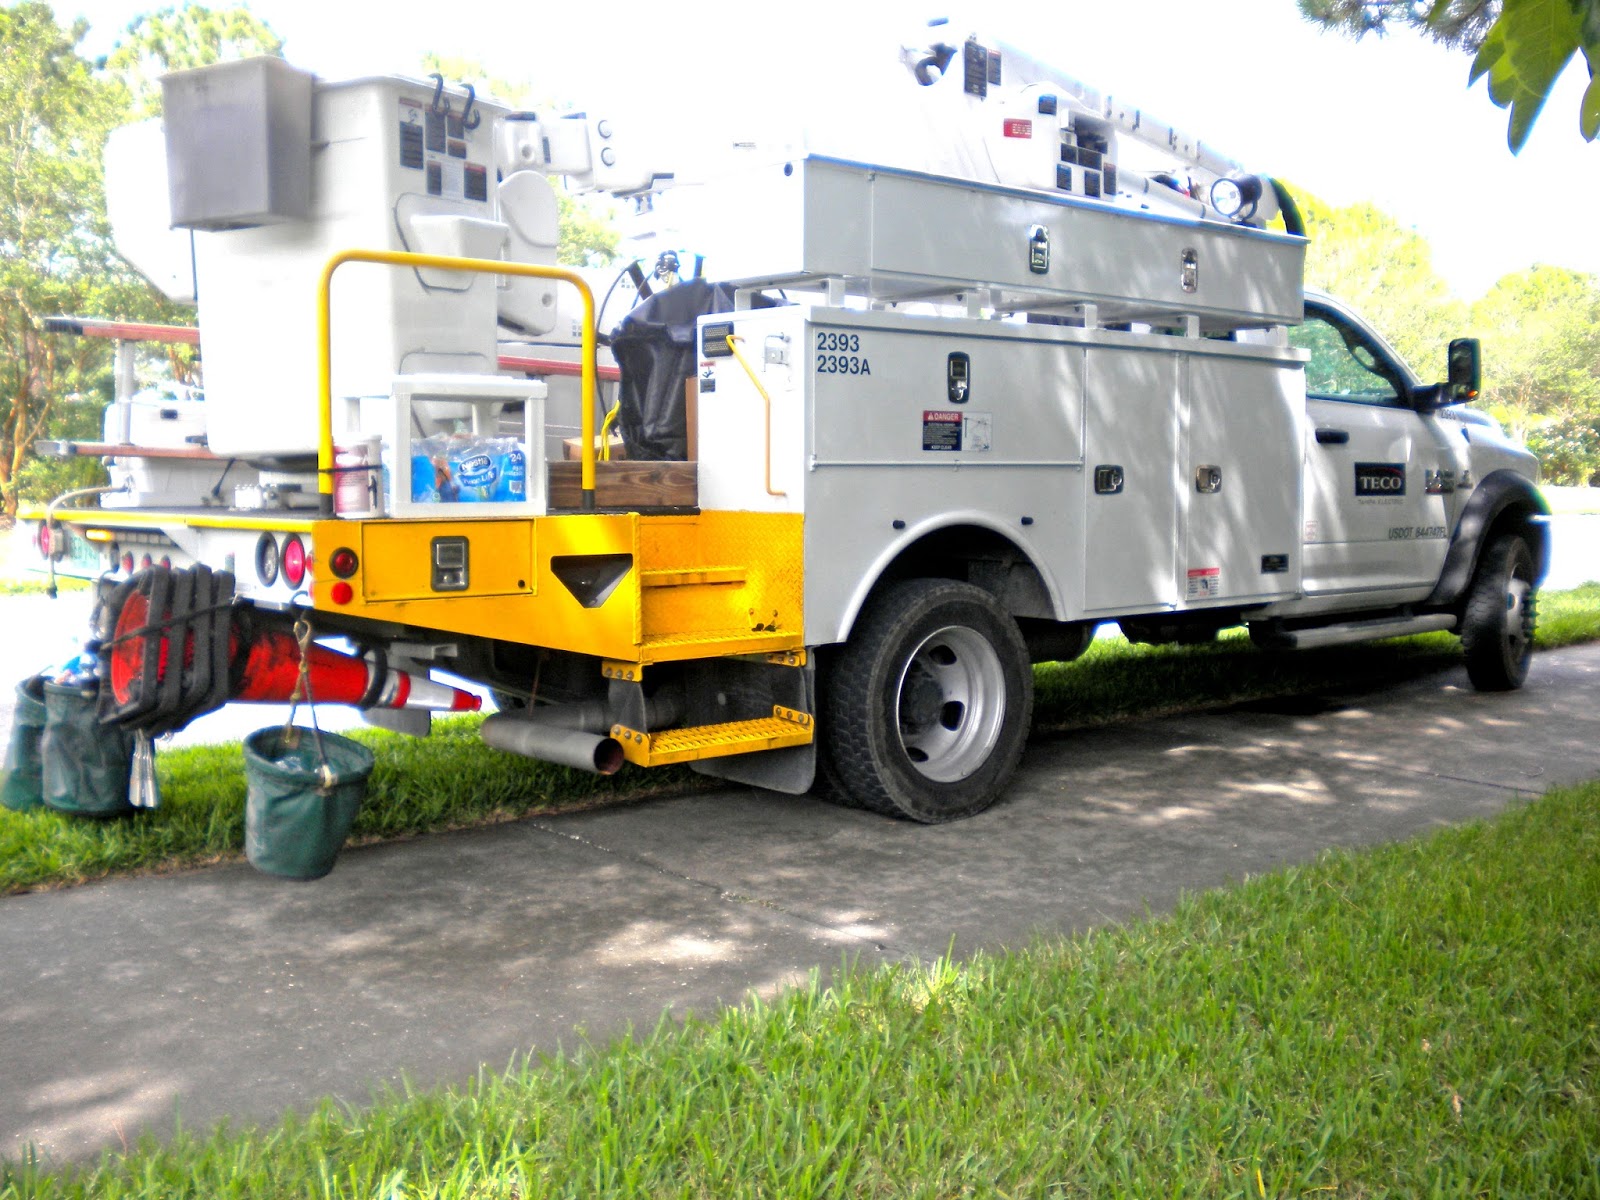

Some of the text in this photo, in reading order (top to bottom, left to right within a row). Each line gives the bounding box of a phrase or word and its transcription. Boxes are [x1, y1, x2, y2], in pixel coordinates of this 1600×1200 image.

[817, 332, 860, 352] 2393
[817, 354, 871, 375] 2393A
[934, 412, 959, 421] DANGER
[509, 453, 522, 463] 24
[1360, 476, 1402, 490] TECO
[1388, 527, 1414, 539] USDOT
